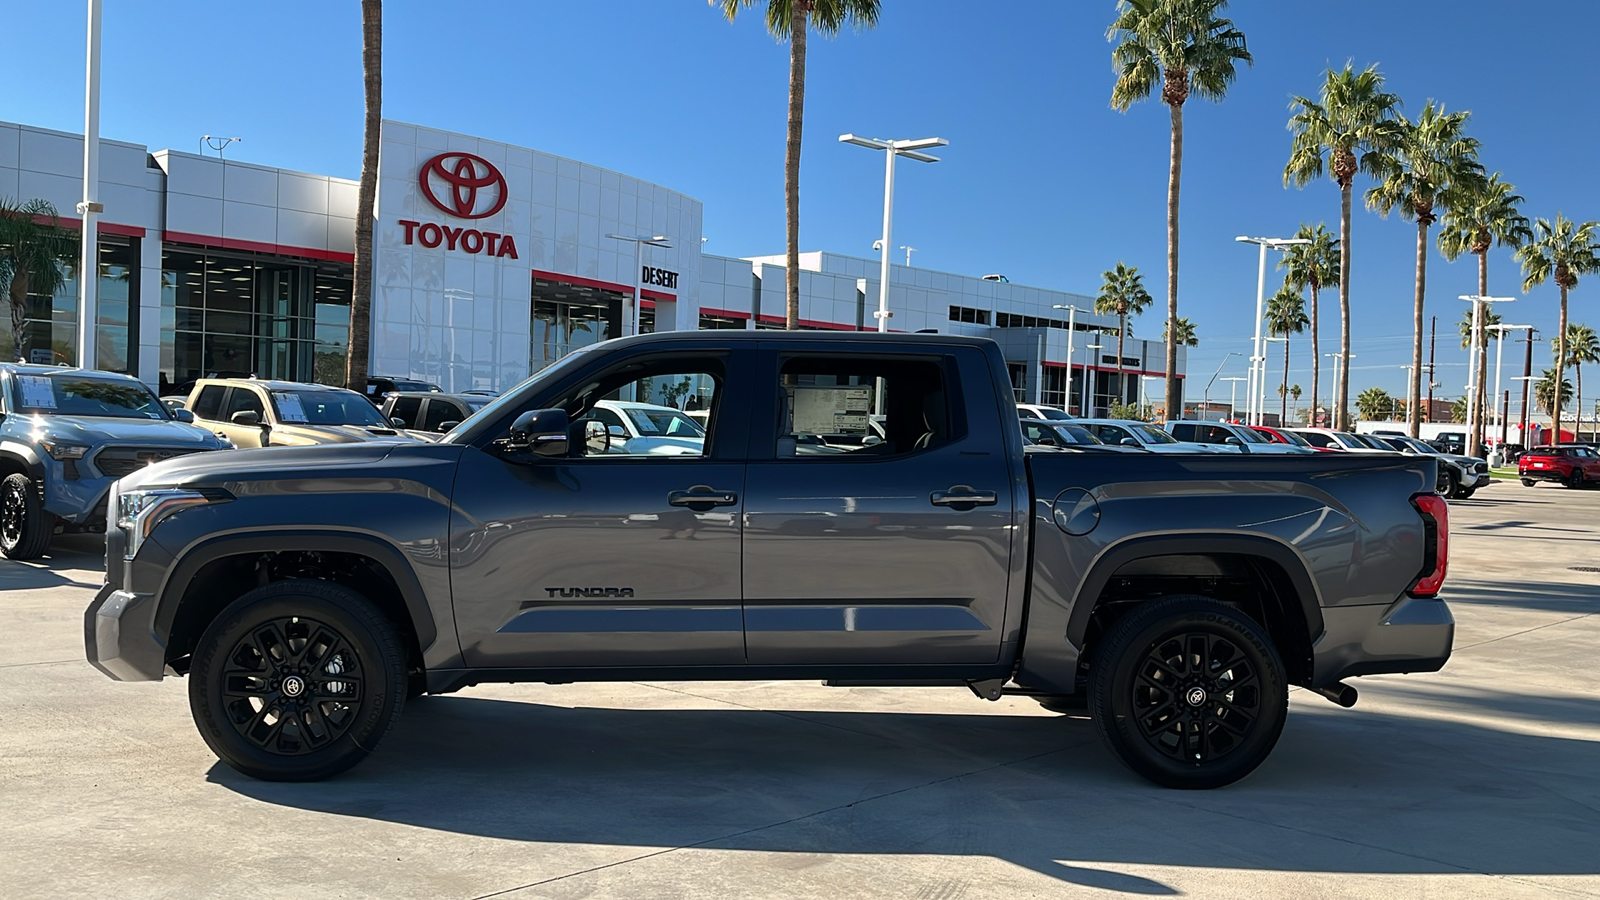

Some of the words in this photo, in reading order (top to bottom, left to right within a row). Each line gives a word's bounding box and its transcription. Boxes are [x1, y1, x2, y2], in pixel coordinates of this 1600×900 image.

[398, 220, 519, 259] TOYOTA
[642, 266, 678, 288] DESERT
[544, 587, 634, 598] TUNDRA
